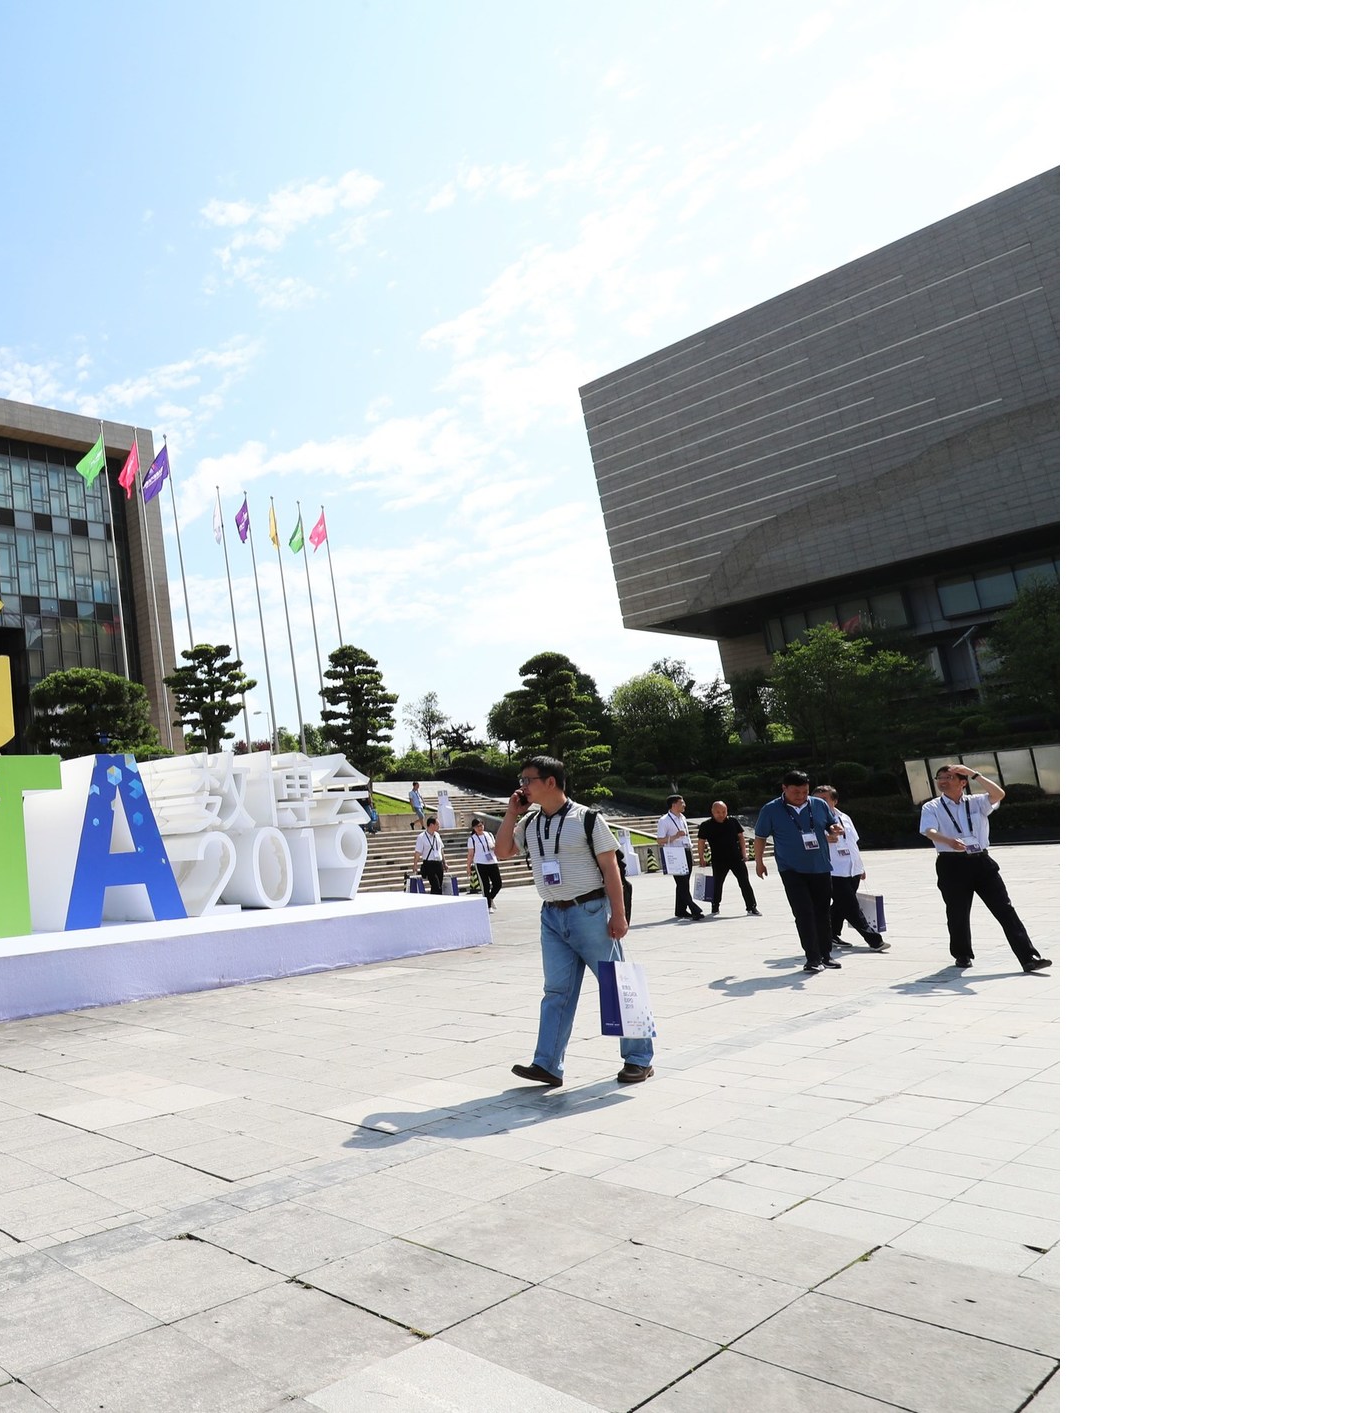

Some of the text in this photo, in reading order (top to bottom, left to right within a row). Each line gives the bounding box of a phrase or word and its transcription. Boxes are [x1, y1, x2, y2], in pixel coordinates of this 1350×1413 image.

[189, 750, 372, 829] 数博会
[197, 823, 369, 917] 2019
